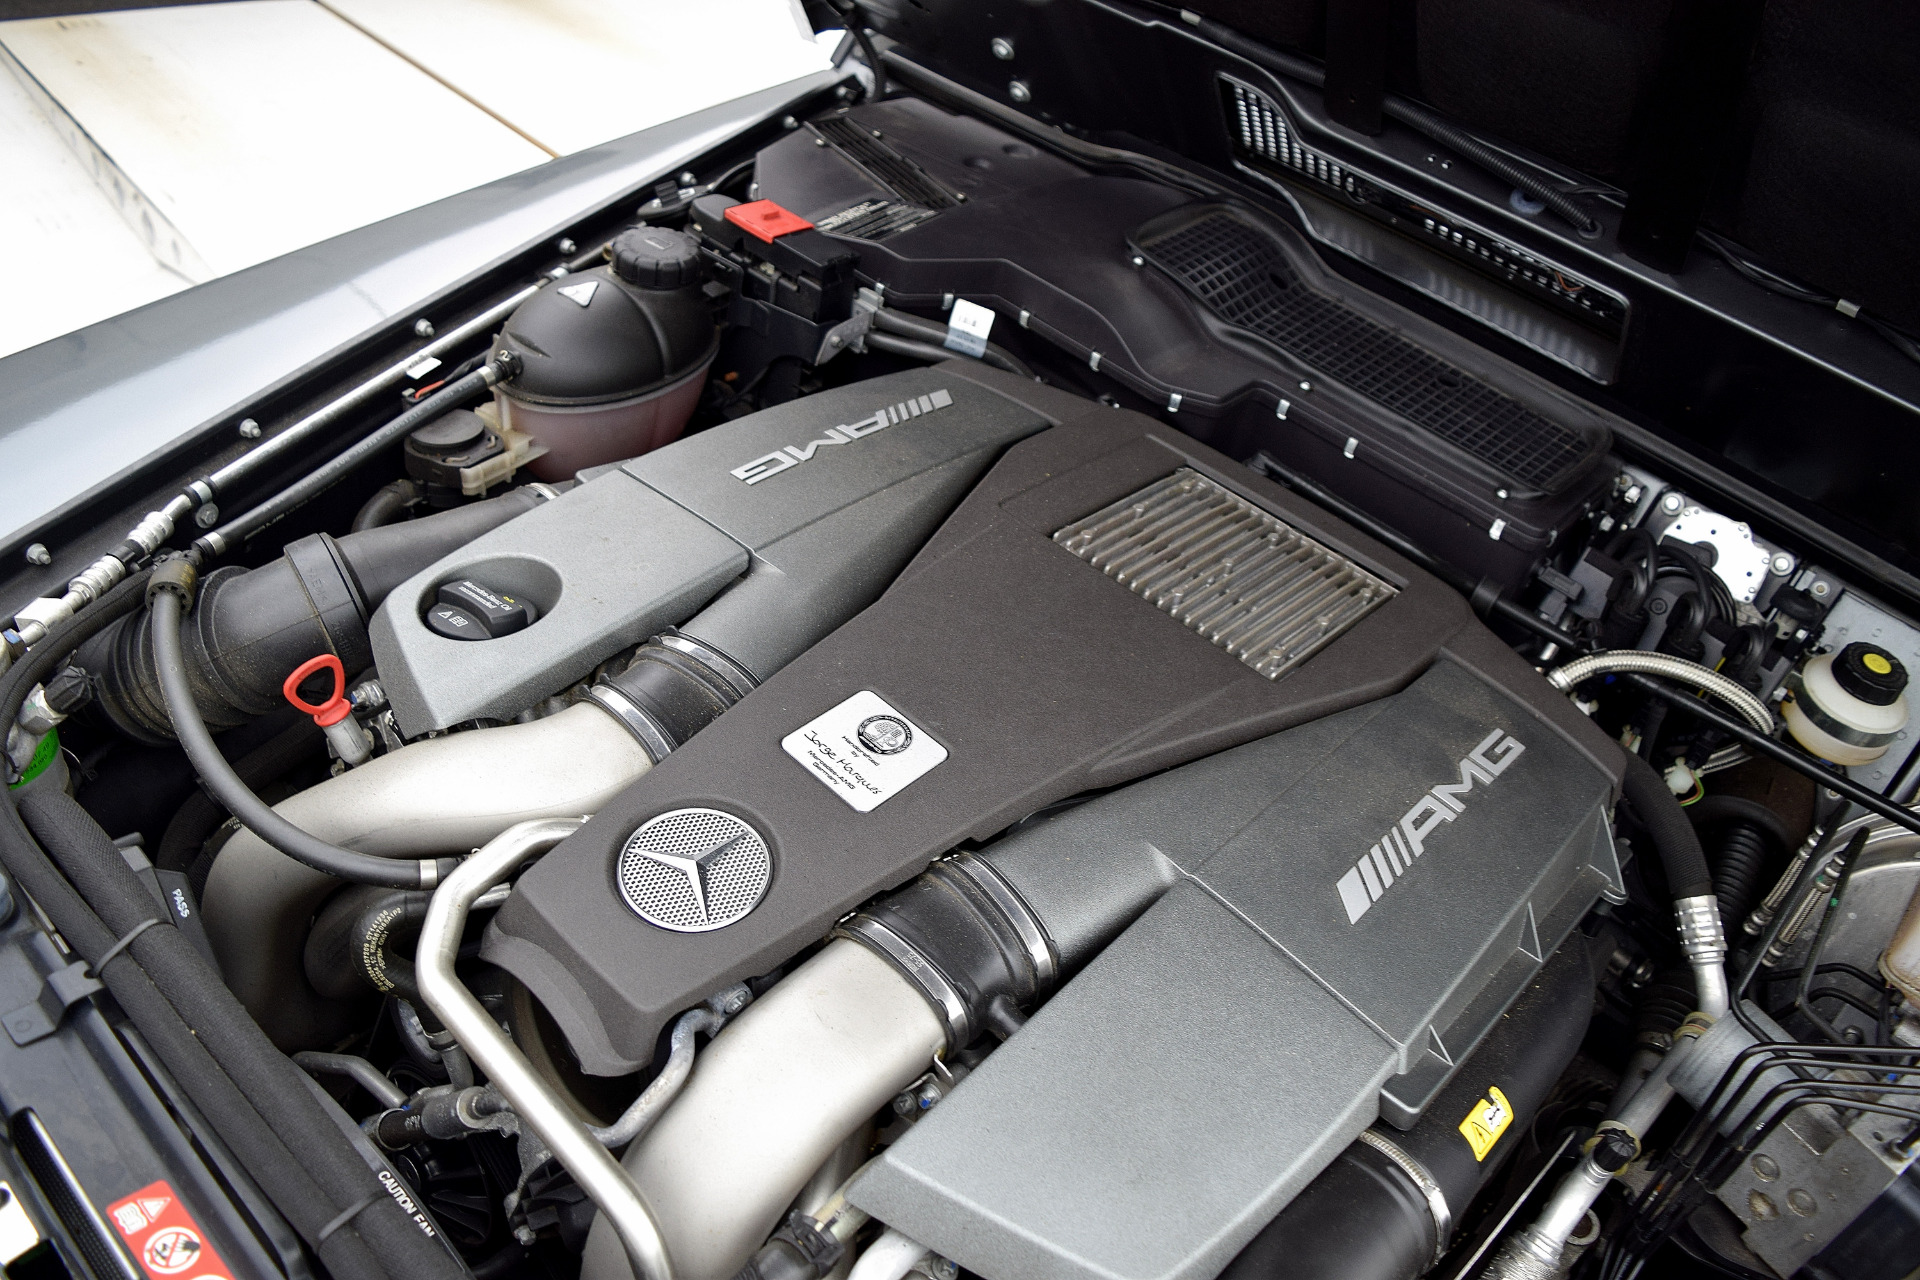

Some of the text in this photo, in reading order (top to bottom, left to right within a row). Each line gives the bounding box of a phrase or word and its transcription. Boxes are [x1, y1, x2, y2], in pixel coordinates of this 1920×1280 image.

[730, 409, 890, 486] AMG
[841, 735, 881, 767] Handcrafted
[851, 750, 860, 758] by
[807, 750, 857, 790] Mercedes-AMG
[812, 762, 841, 785] Germany
[1400, 728, 1526, 858] AMG
[172, 888, 190, 918] PASS
[378, 1170, 436, 1238] CAUTION FAN
